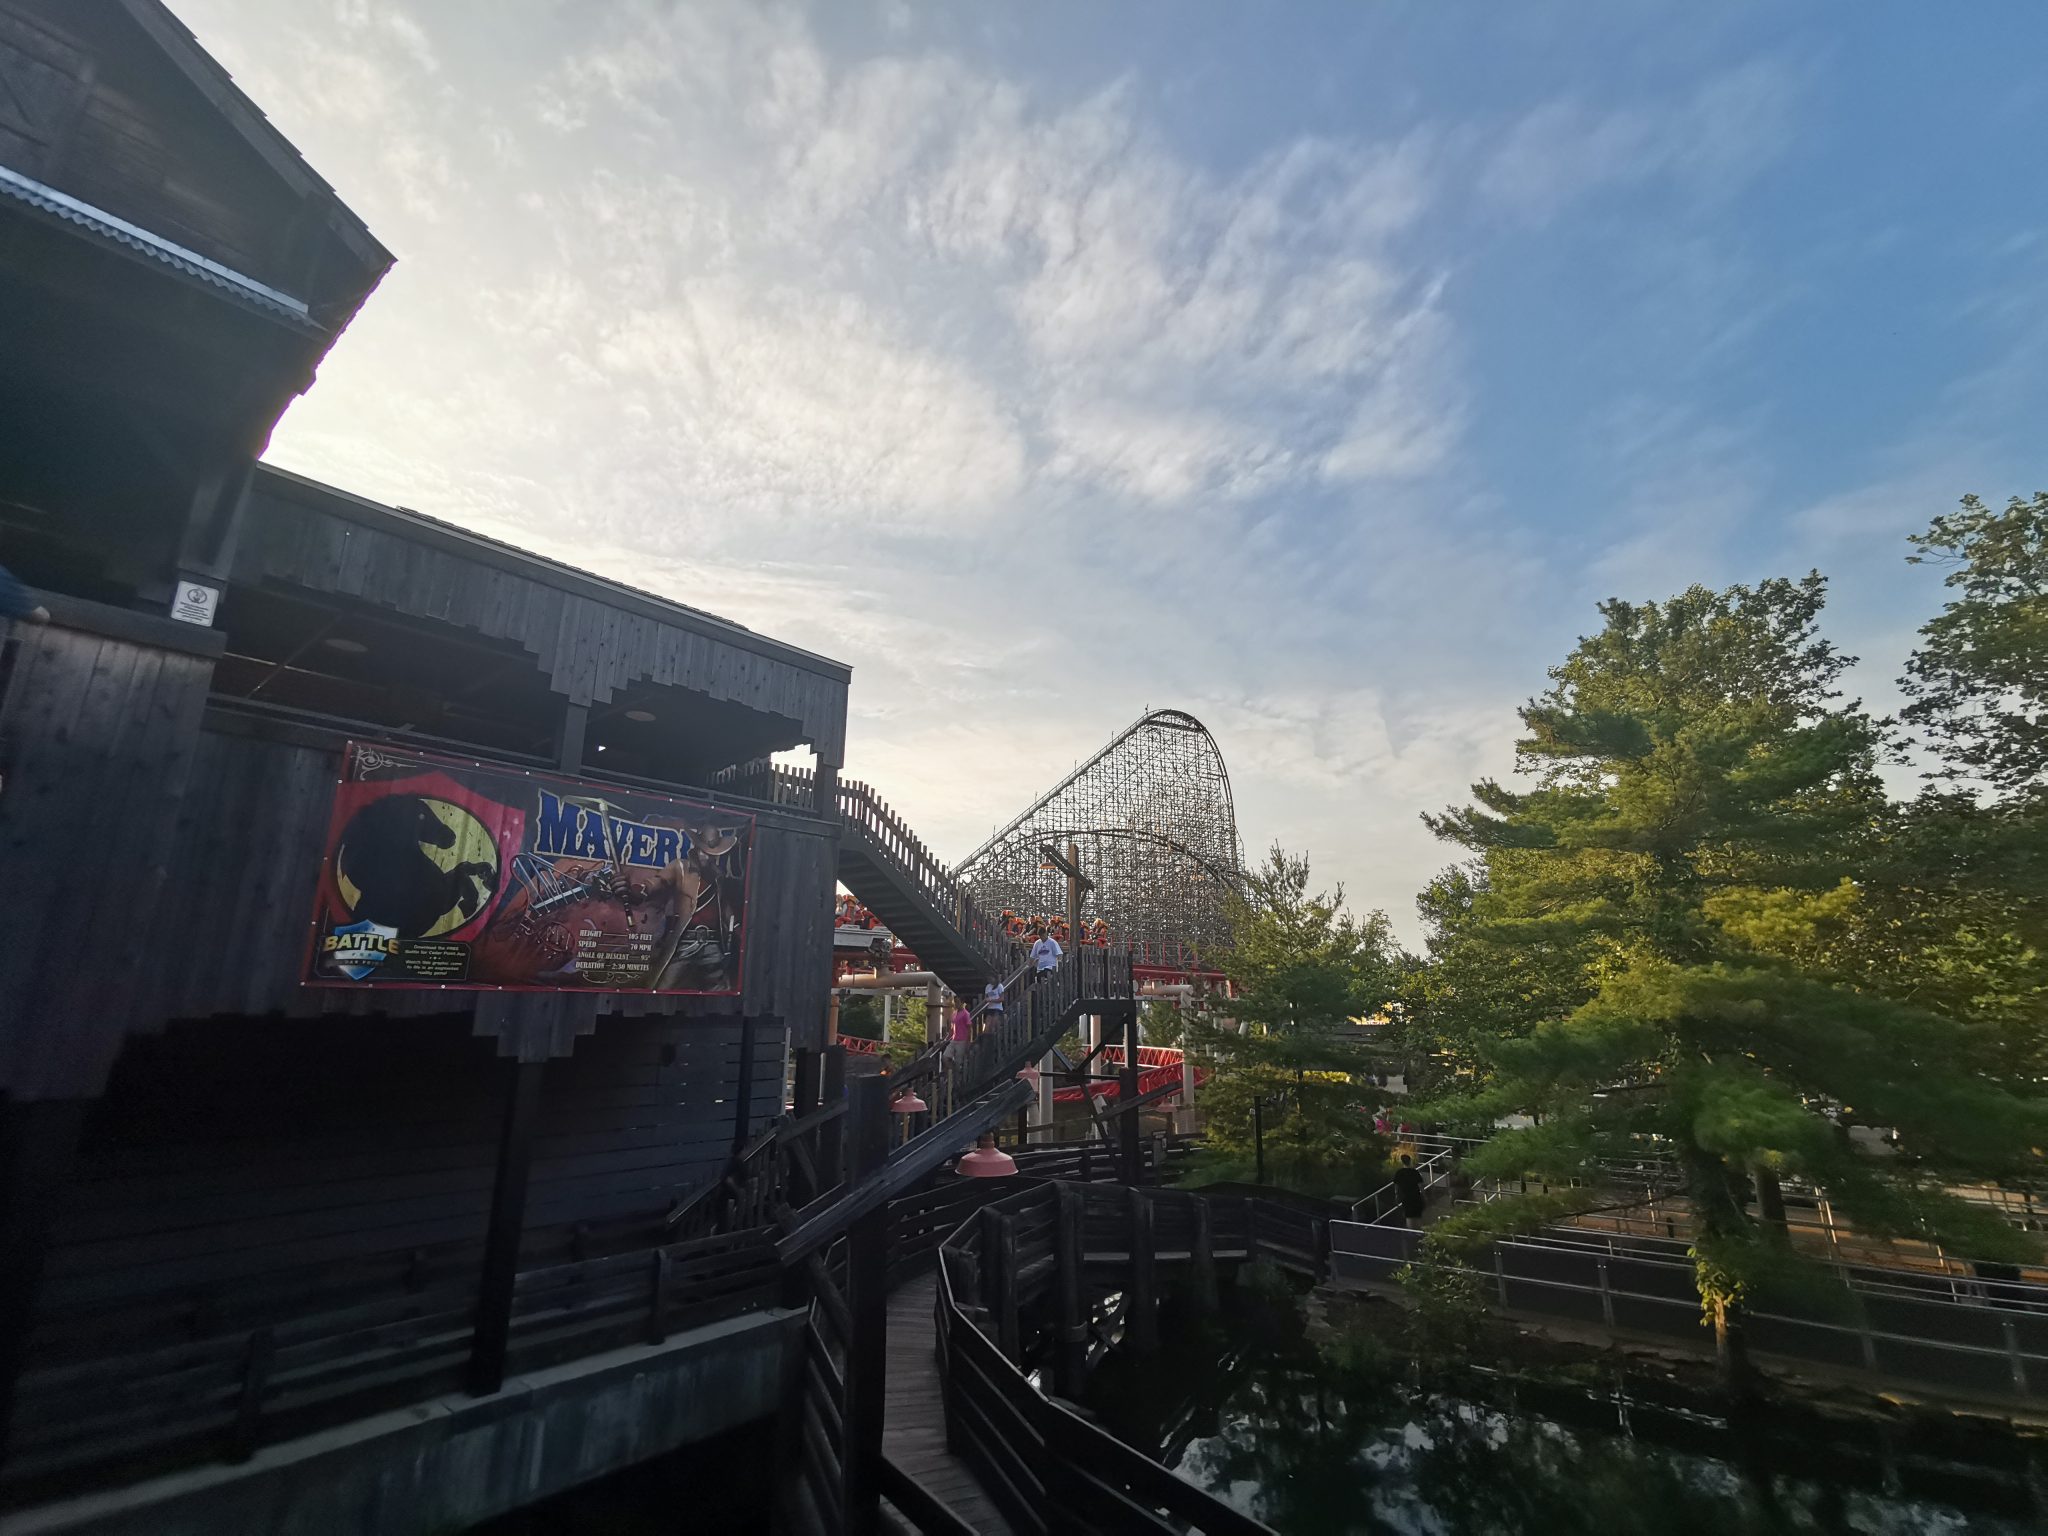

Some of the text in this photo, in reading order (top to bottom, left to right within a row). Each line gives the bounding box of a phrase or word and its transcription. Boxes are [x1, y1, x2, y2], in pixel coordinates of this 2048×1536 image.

[534, 788, 746, 879] MAVERI
[579, 929, 602, 938] HEIGHT
[639, 933, 653, 941] FEET
[323, 933, 400, 955] BATTLE
[578, 940, 597, 948] SPEED
[576, 951, 596, 959] ANGLE
[605, 952, 630, 960] DESCENT
[575, 961, 650, 971] DURATION 2:30 MINUTES
